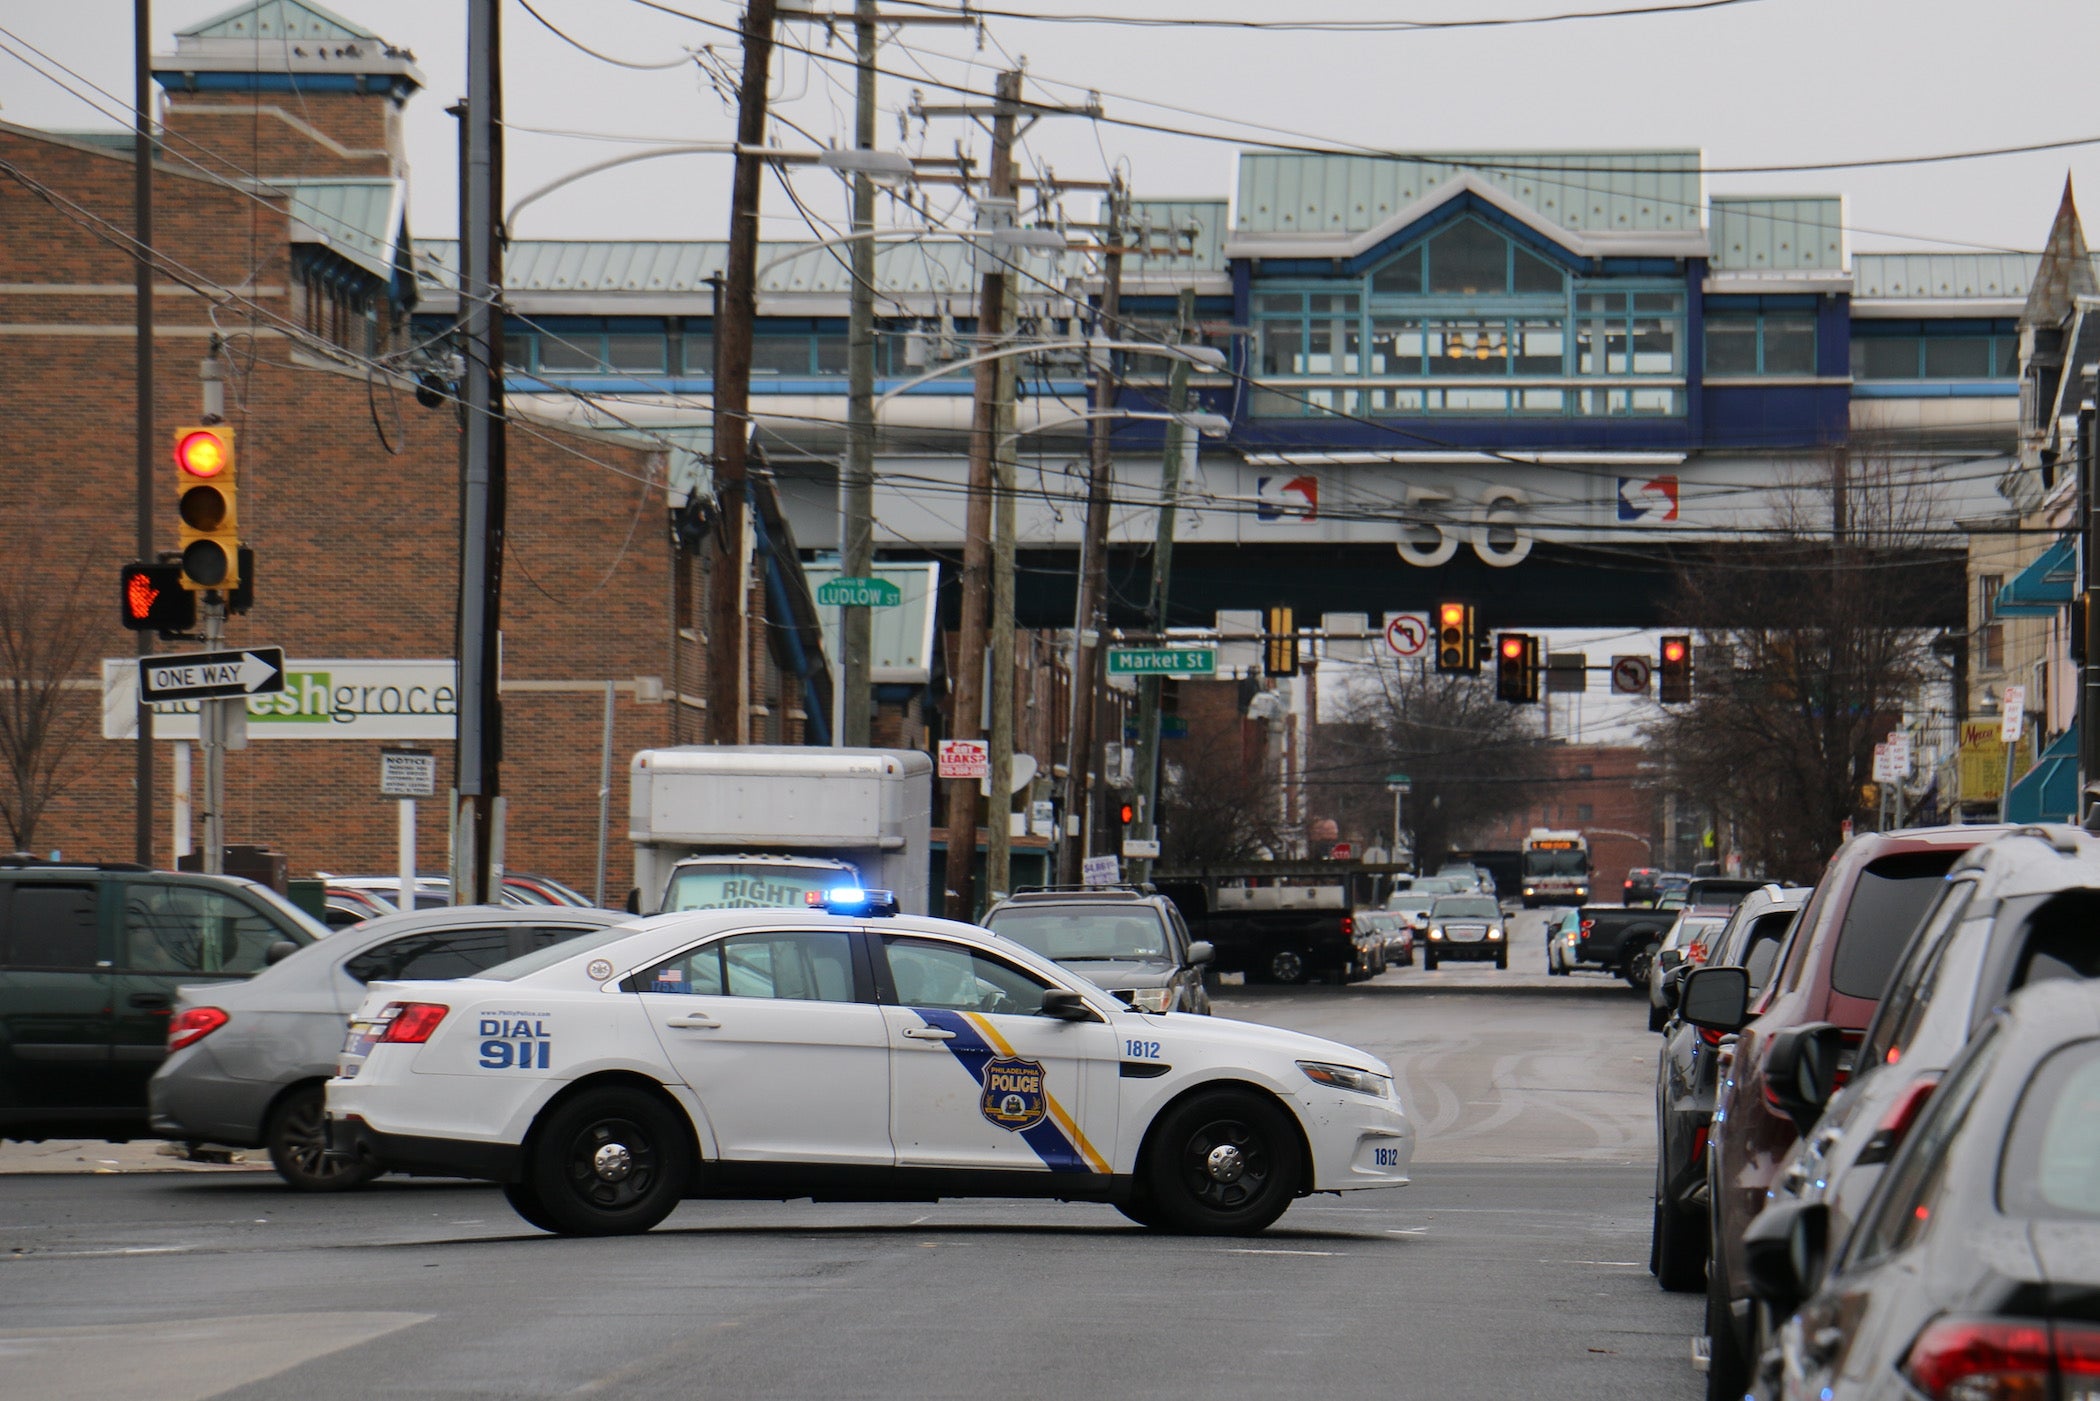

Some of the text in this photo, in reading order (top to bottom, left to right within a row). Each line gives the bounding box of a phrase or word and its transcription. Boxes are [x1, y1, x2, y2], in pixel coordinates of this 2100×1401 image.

[1397, 485, 1533, 567] 56
[821, 588, 899, 605] LUDLOW ST
[1120, 653, 1204, 669] Market St
[157, 664, 242, 688] ONE WAY
[941, 754, 987, 764] LEAKS?
[721, 878, 802, 906] RIGHT
[480, 1019, 551, 1038] DIAL
[479, 1040, 551, 1069] 911
[1126, 1039, 1160, 1059] 1812
[991, 1066, 1039, 1076] PHILADELPHIA
[991, 1074, 1039, 1093] POLICE
[1375, 1147, 1398, 1166] 1812
